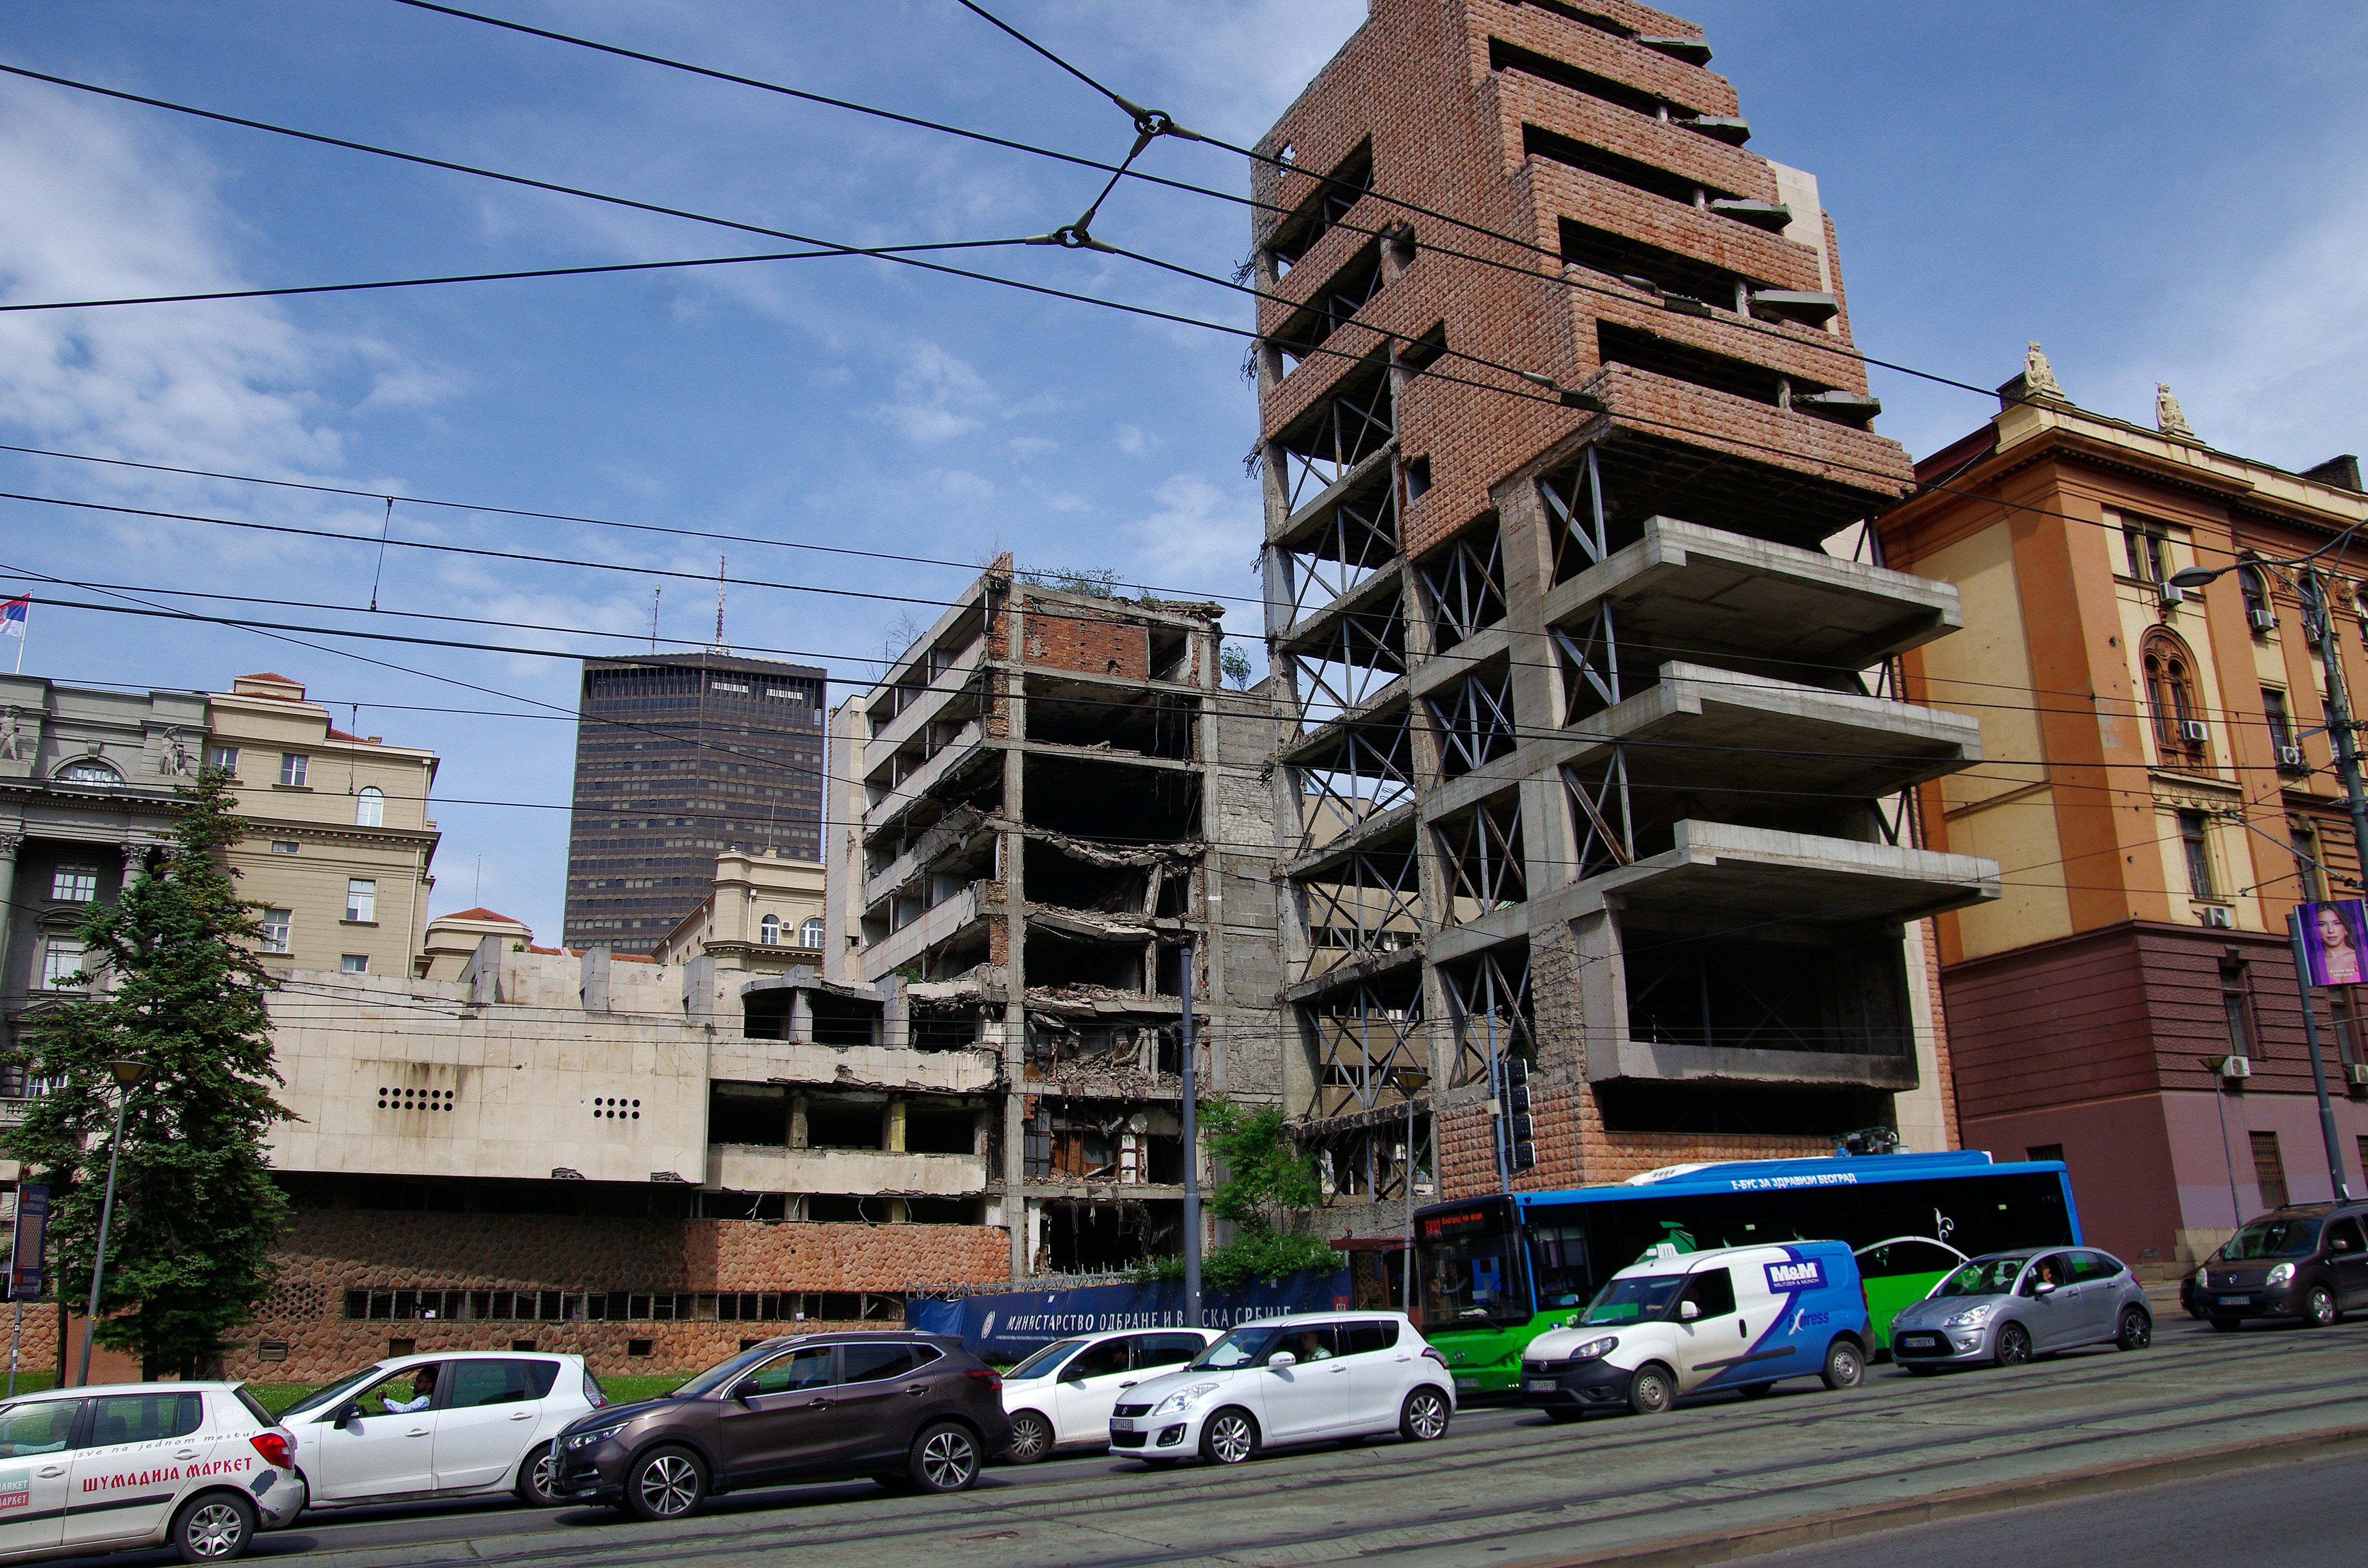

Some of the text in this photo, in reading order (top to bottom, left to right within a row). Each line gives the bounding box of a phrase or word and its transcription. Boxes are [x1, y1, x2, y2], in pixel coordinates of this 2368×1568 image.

[1731, 1173, 1858, 1190] Е-БУС ЗА ЗДРАВИЈИ БЕОГРАД
[1769, 1262, 1818, 1283] M&M
[1006, 1313, 1095, 1331] МИНИСТАРСТВО
[1099, 1312, 1158, 1331] ОДБРАНЕ
[1163, 1311, 1171, 1328] И
[1177, 1309, 1229, 1328] ВСКА
[77, 1448, 103, 1458] sve
[138, 1436, 195, 1452] jednom
[204, 1430, 257, 1441] mestu!
[83, 1457, 252, 1492] ШУМАДИЈА МАРКЕТ
[0, 1480, 28, 1492] ARKET
